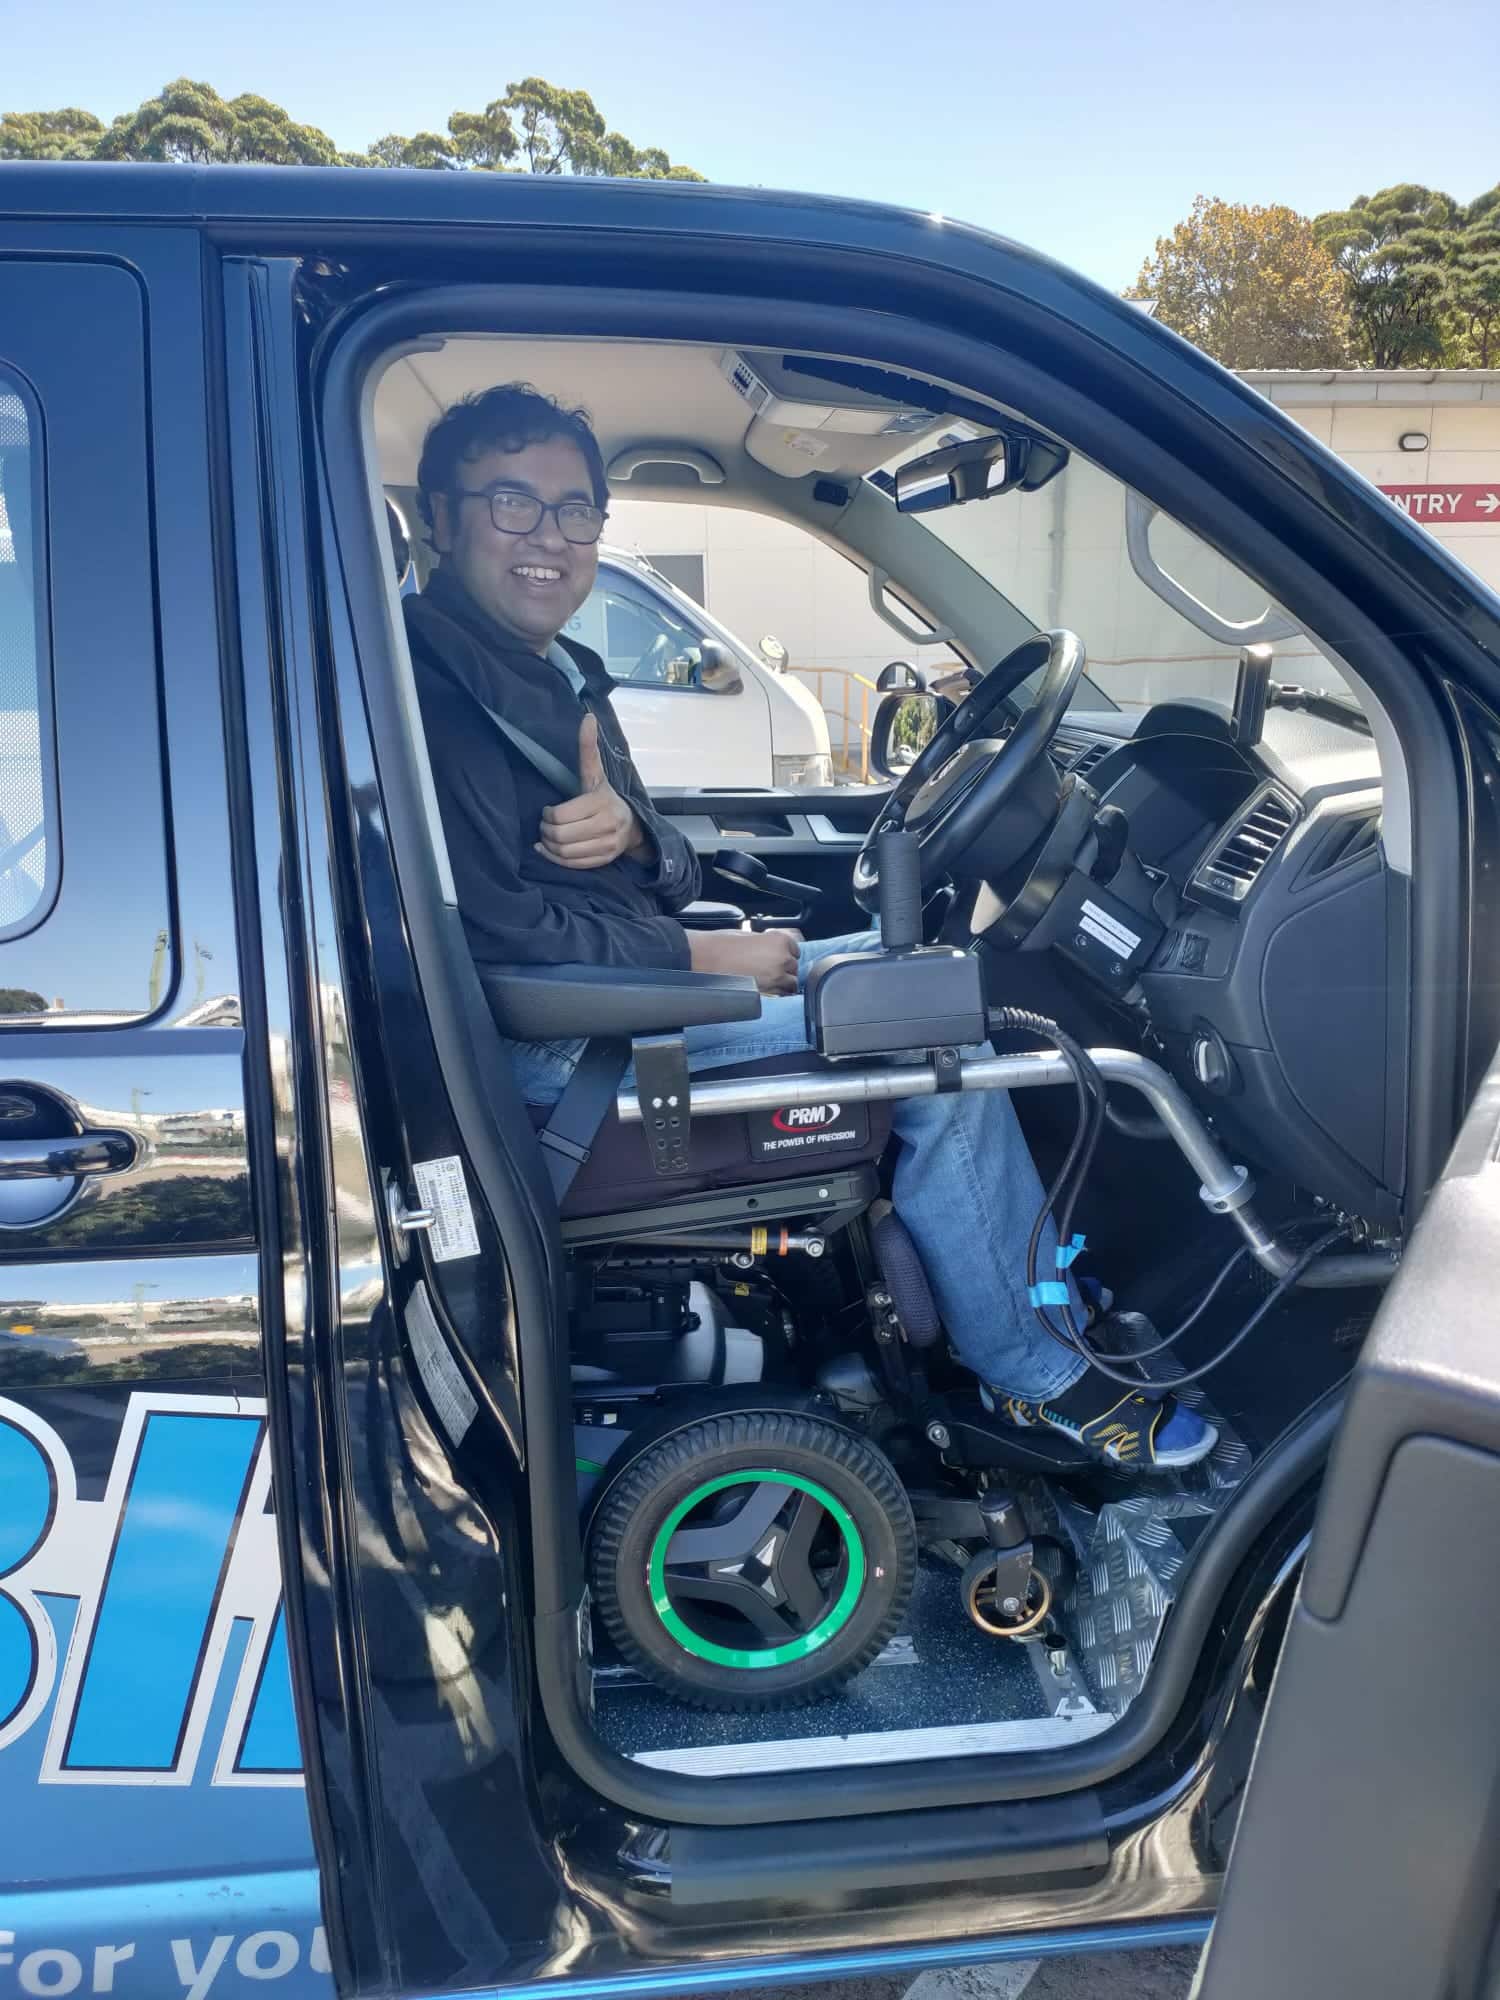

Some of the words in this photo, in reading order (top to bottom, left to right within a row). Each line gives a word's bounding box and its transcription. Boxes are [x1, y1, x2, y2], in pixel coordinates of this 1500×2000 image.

[1386, 492, 1463, 514] NTRY
[788, 1105, 826, 1126] PRM
[763, 1141, 777, 1152] THE
[777, 1136, 805, 1149] POWER
[806, 1135, 817, 1144] OF
[817, 1130, 856, 1143] PRECISION
